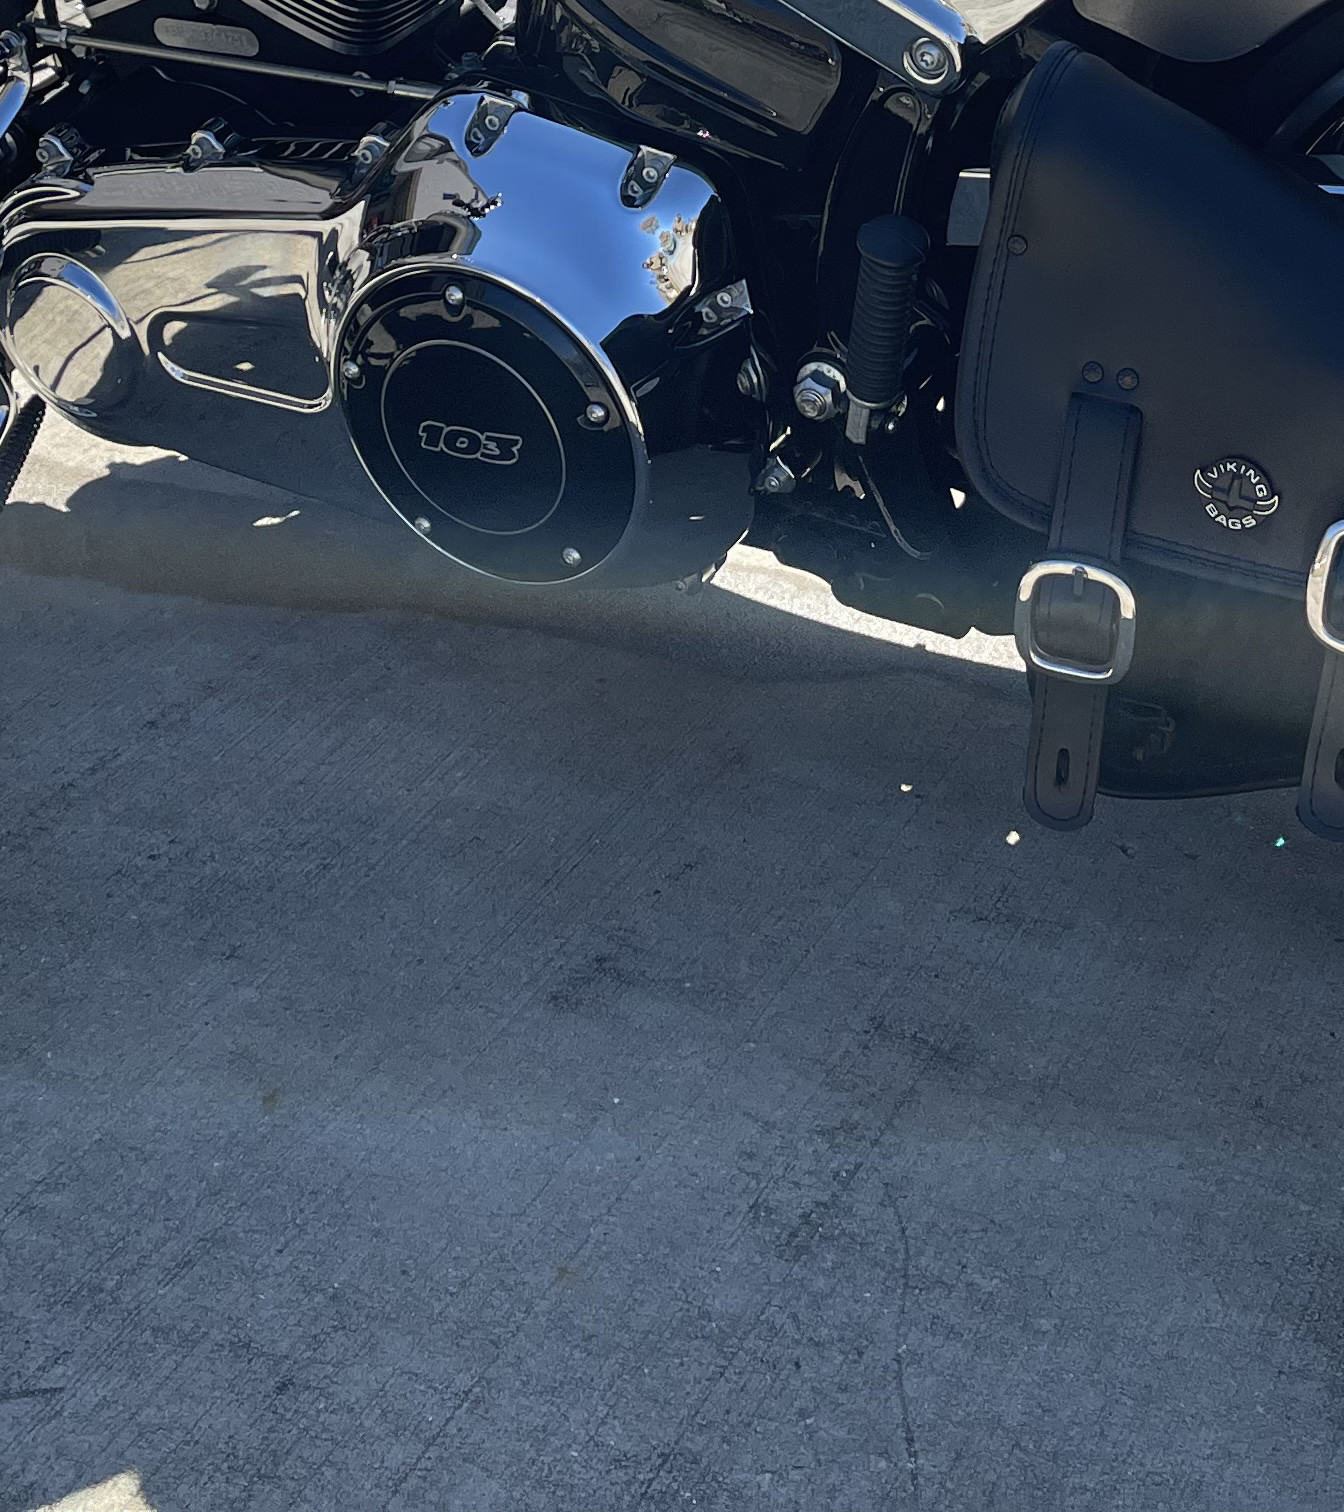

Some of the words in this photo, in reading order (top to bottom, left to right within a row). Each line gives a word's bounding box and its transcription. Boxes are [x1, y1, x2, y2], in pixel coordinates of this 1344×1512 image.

[417, 420, 523, 465] 103
[1206, 461, 1268, 498] VIKING
[1205, 502, 1257, 530] BAGS
